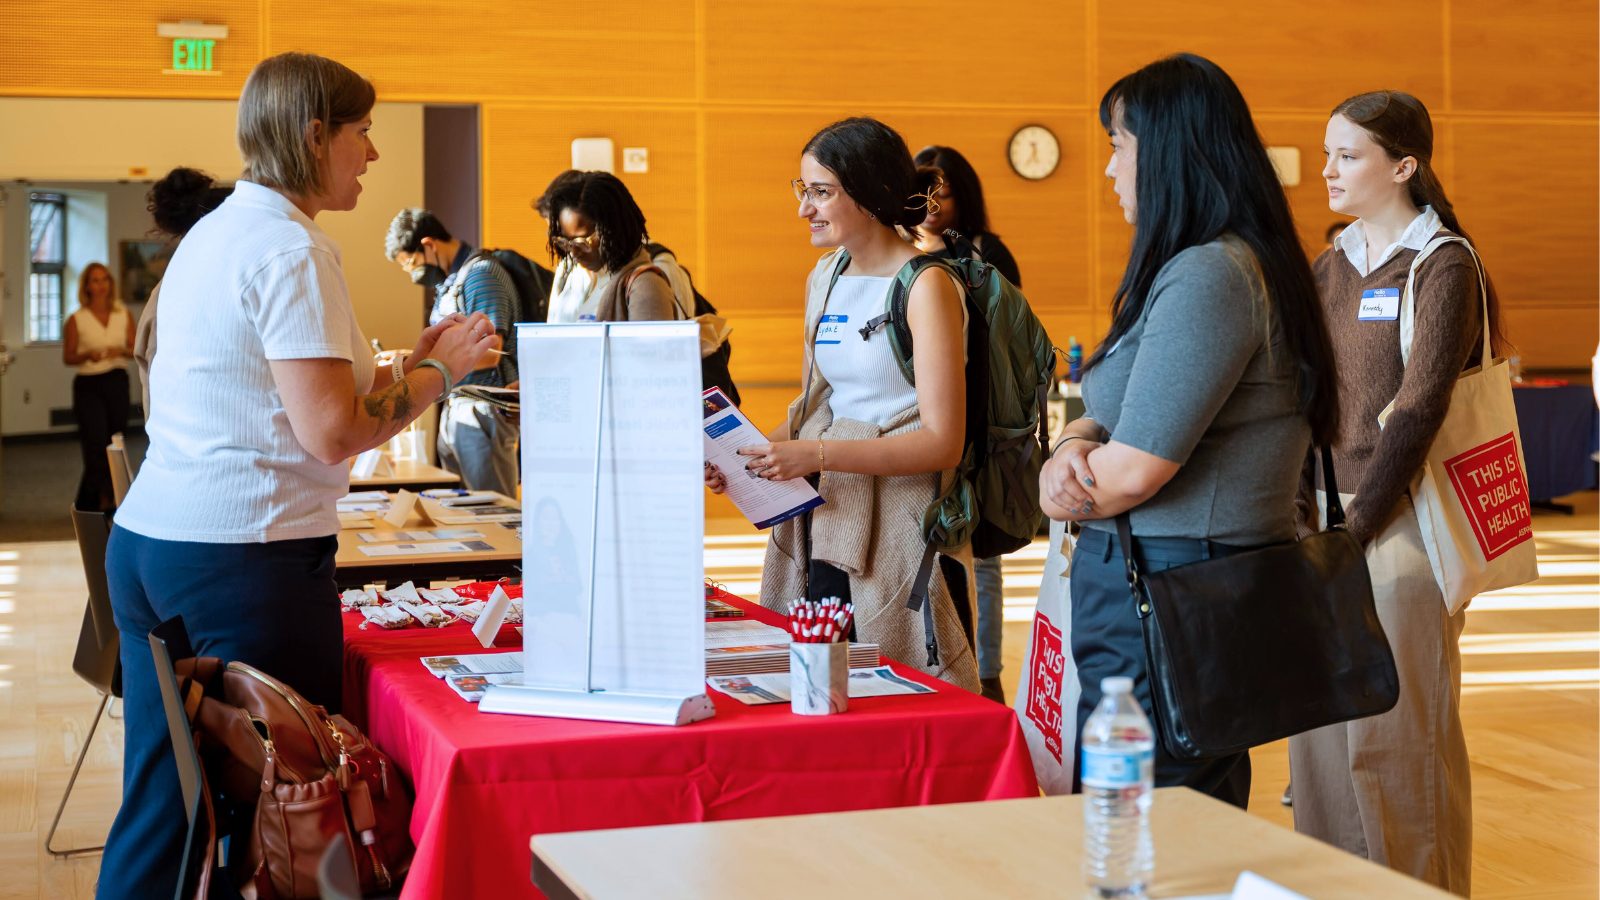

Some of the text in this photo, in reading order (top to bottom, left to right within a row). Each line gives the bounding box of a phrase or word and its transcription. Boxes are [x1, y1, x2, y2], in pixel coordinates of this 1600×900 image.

[173, 39, 215, 71] EXIT
[1467, 454, 1516, 488] THIS IS
[1477, 478, 1521, 513] PUBLIC
[1487, 501, 1529, 537] HEALTH
